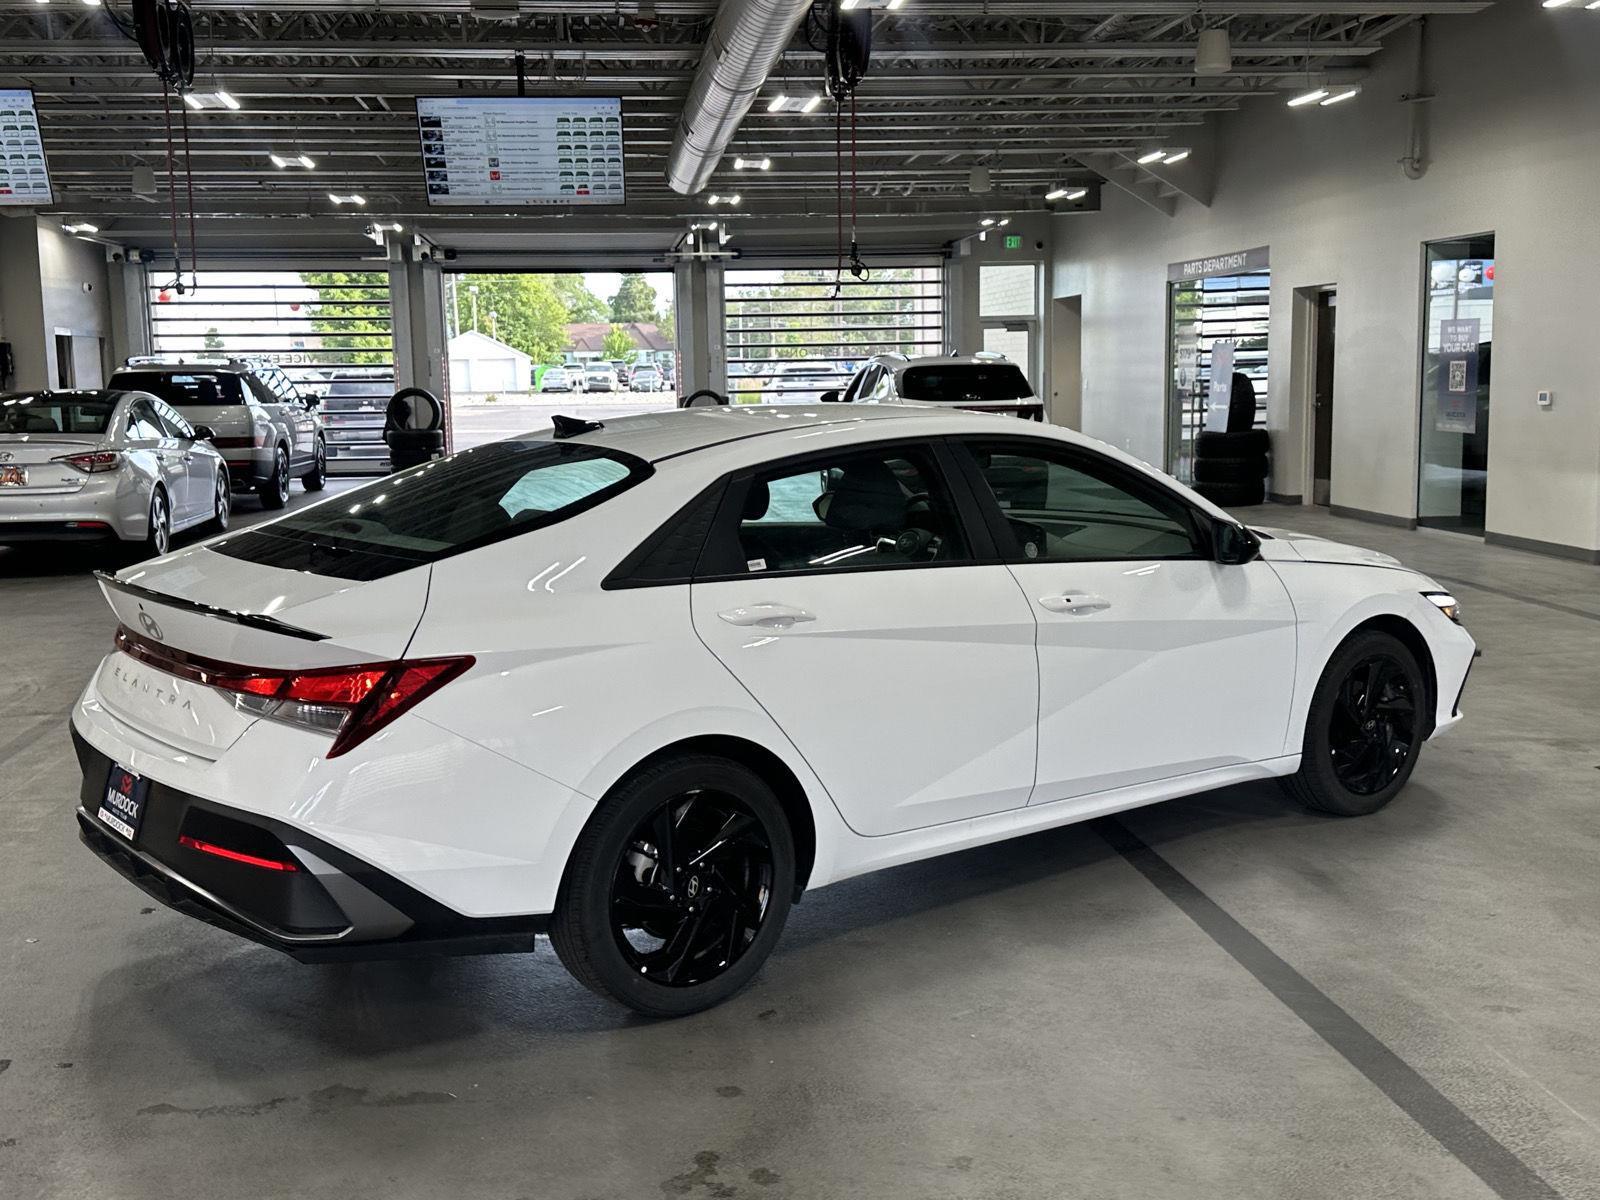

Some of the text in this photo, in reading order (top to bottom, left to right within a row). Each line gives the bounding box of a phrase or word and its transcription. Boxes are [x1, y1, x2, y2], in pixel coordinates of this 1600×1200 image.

[1006, 236, 1021, 248] EXIT
[1183, 253, 1247, 275] PARTS DEPARTMENT
[1442, 343, 1475, 352] YOUR CAR
[113, 667, 191, 710] ELANTRA
[107, 787, 139, 819] MURDOCK
